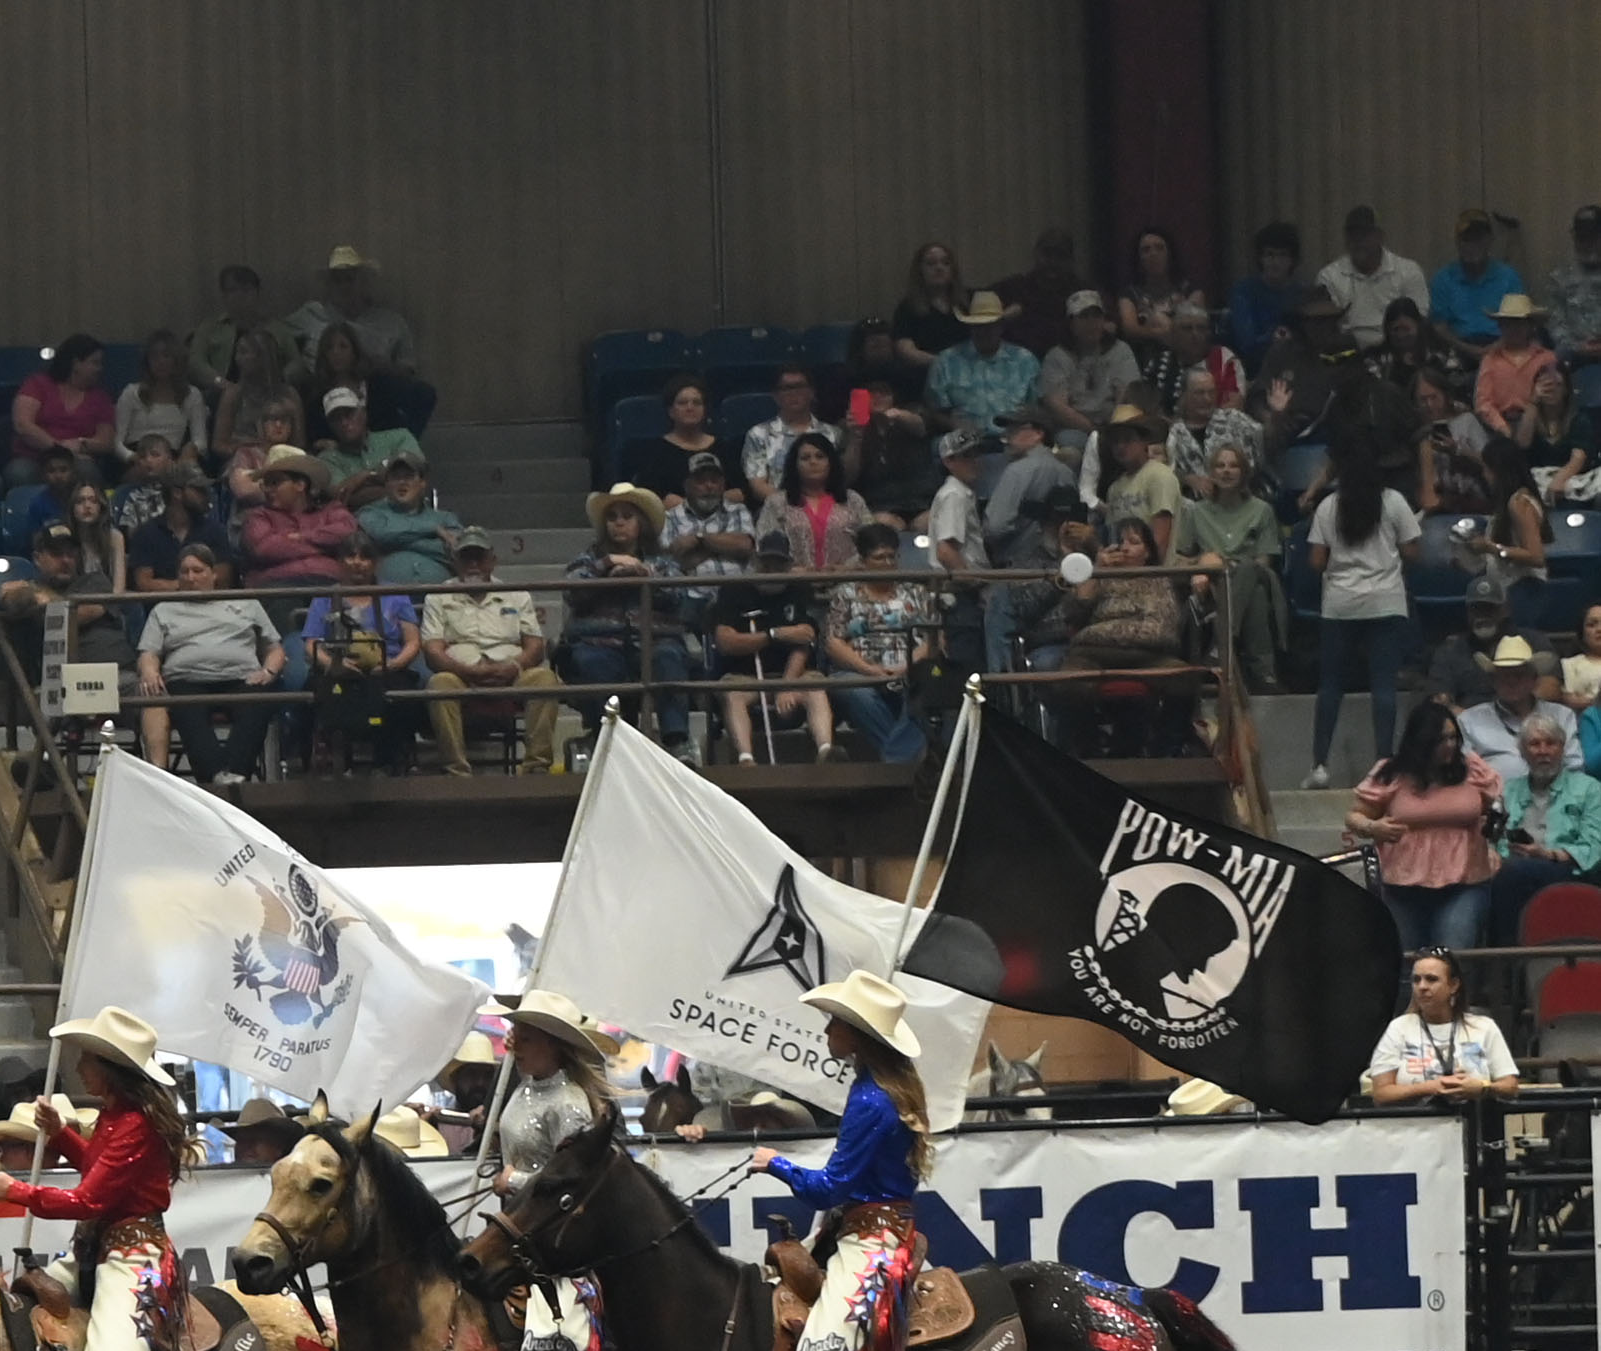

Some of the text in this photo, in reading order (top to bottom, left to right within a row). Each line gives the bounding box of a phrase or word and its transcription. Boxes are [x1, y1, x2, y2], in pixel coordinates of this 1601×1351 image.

[512, 536, 524, 553] 3
[214, 843, 256, 888] UNITED
[705, 990, 827, 1044] UNITED STATE
[1067, 949, 1240, 1050] YOU ARE NOT FORGOTTEN
[223, 1002, 332, 1056] SEMPER PARATUS
[669, 999, 855, 1085] SPACE FORCE
[253, 1045, 293, 1073] 1790
[691, 1172, 1422, 1314] NCH
